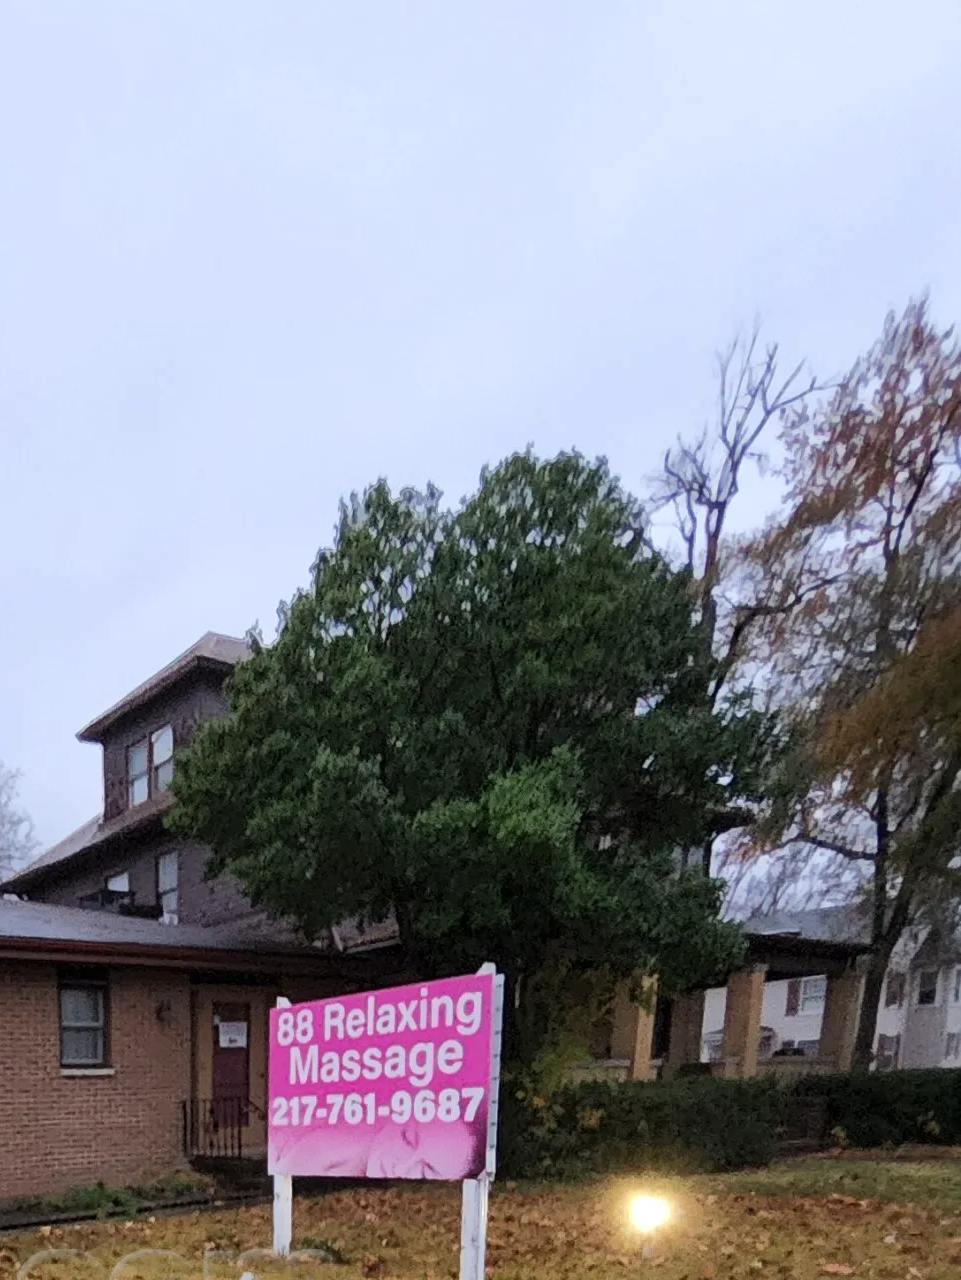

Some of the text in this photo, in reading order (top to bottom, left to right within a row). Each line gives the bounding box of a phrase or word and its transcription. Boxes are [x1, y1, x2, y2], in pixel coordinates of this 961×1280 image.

[277, 987, 483, 1046] 88 Relaxing
[289, 1038, 464, 1087] Massage
[272, 1087, 485, 1126] 217-761-9687
